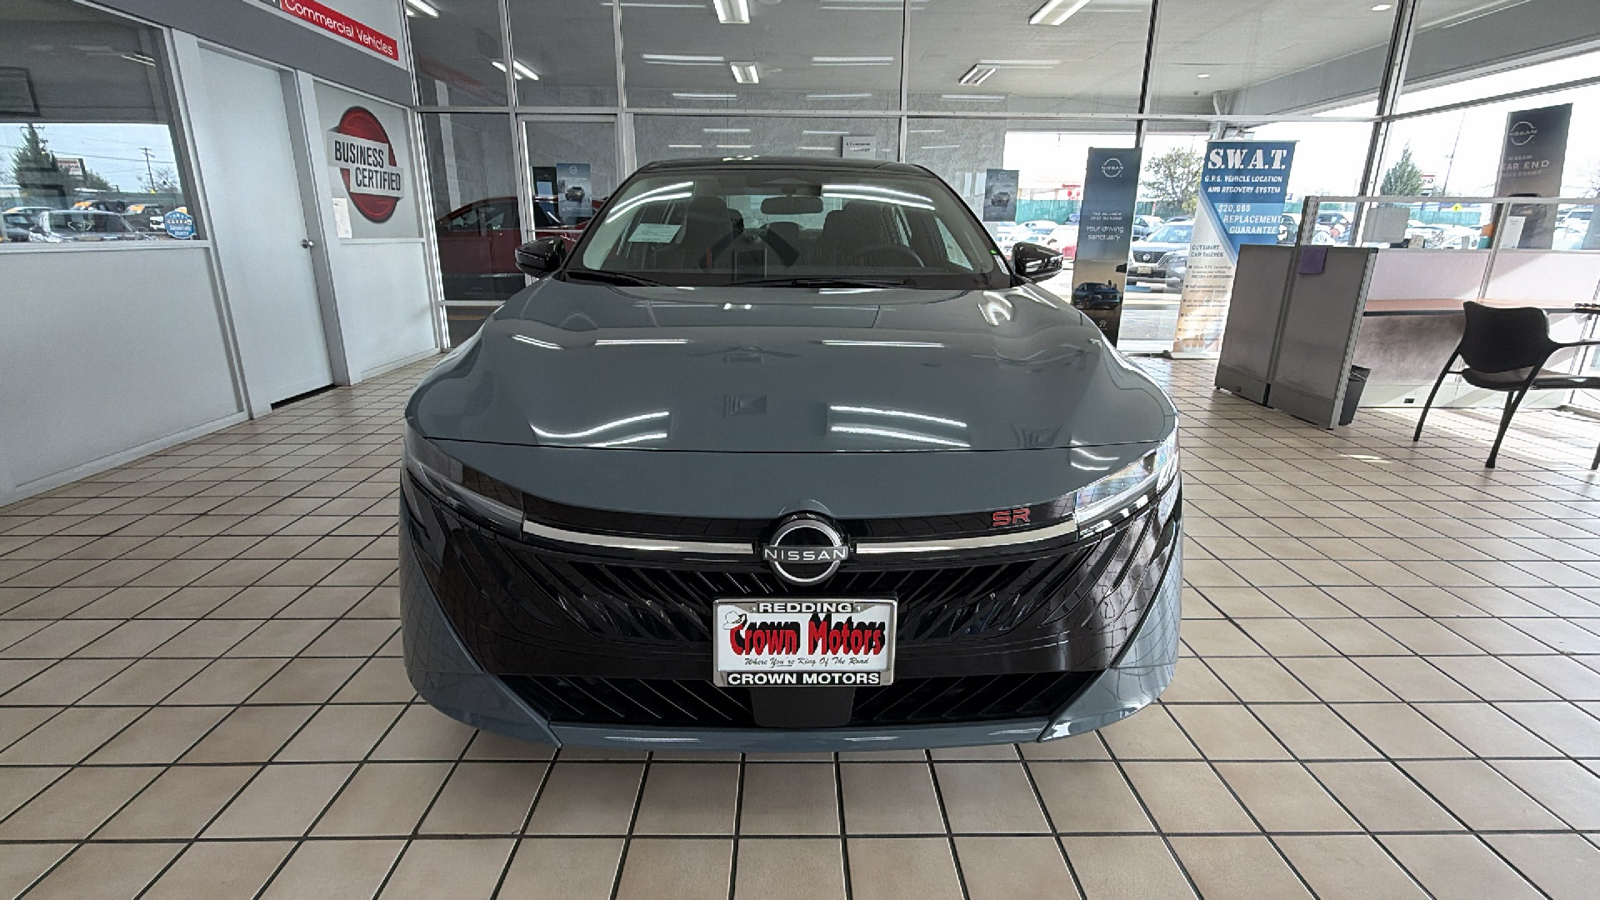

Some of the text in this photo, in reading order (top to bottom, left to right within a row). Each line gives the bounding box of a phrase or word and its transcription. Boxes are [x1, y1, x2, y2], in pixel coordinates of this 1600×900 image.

[284, 0, 393, 55] Commercial Vehicles
[334, 139, 384, 169] BUSINESS
[1207, 148, 1287, 169] S.W.A.T.
[1523, 160, 1549, 169] END
[355, 166, 401, 191] CERTIFIED
[1251, 175, 1283, 183] LOCATION
[1221, 186, 1254, 194] RECOVERY
[1254, 186, 1281, 194] SYSTEM
[1223, 214, 1283, 224] REPLACEMENT
[1101, 225, 1124, 234] driving
[1229, 226, 1277, 234] GUARANTEE
[1087, 233, 1121, 241] sanctuary
[992, 507, 1031, 527] SR
[764, 548, 847, 561] NISSAN
[759, 602, 853, 613] REDDING
[729, 613, 886, 656] Crown Motors
[744, 657, 768, 666] Where
[797, 657, 816, 667] King
[819, 657, 829, 667] Of
[831, 656, 846, 666] The
[848, 656, 870, 666] Road
[728, 672, 880, 685] CROWN MOTORS
